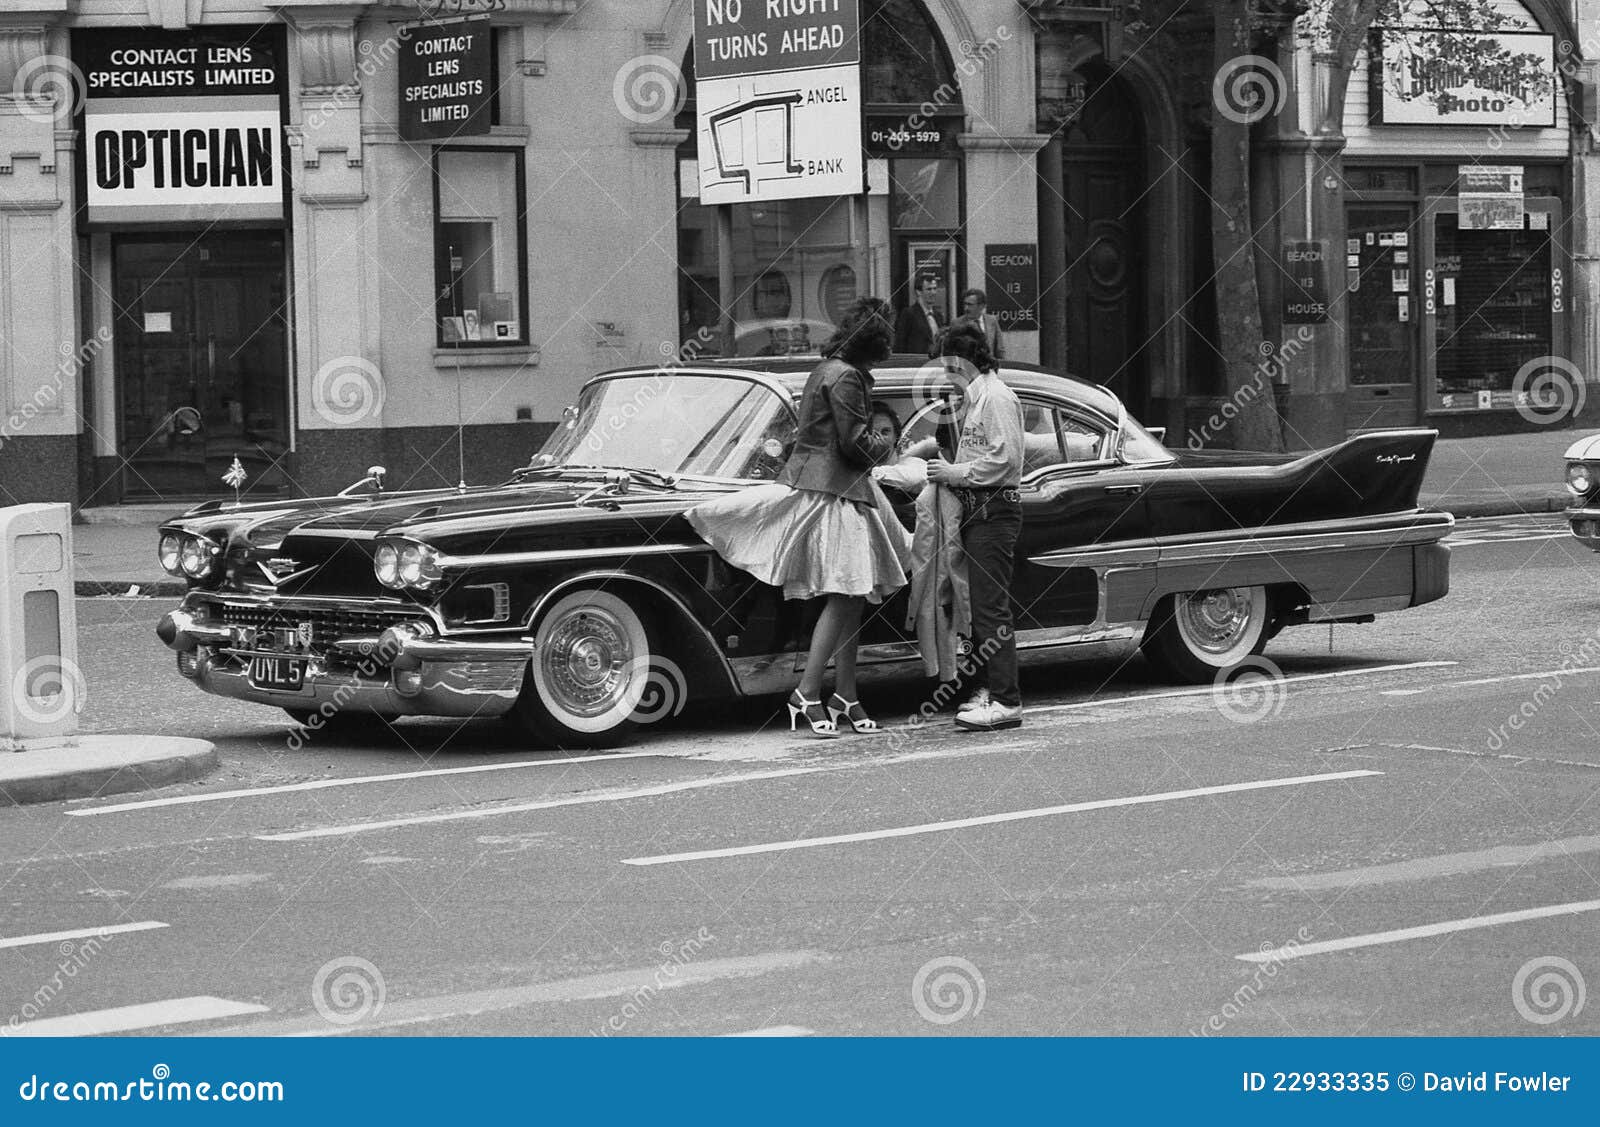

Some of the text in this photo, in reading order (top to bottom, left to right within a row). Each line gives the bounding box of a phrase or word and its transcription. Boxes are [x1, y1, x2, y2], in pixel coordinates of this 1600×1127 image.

[706, 0, 742, 26] NO
[415, 35, 473, 55] CONTACT
[707, 24, 844, 61] TURNS AHEAD
[110, 47, 252, 65] CONTACT LENS
[428, 59, 460, 77] LENS
[89, 68, 275, 87] SPECIALISTS LIMITED
[405, 79, 483, 101] SPECIALISTS
[807, 86, 848, 104] ANGEL
[421, 104, 469, 122] LIMITED
[871, 131, 941, 142] 01-405-5979
[95, 127, 273, 190] OPTICIAN
[808, 158, 844, 175] BANK
[991, 255, 1033, 266] BEACON
[1287, 251, 1325, 262] BEACON
[1006, 282, 1021, 294] 113
[1288, 303, 1325, 314] HOUSE
[255, 658, 300, 683] UYL 5
